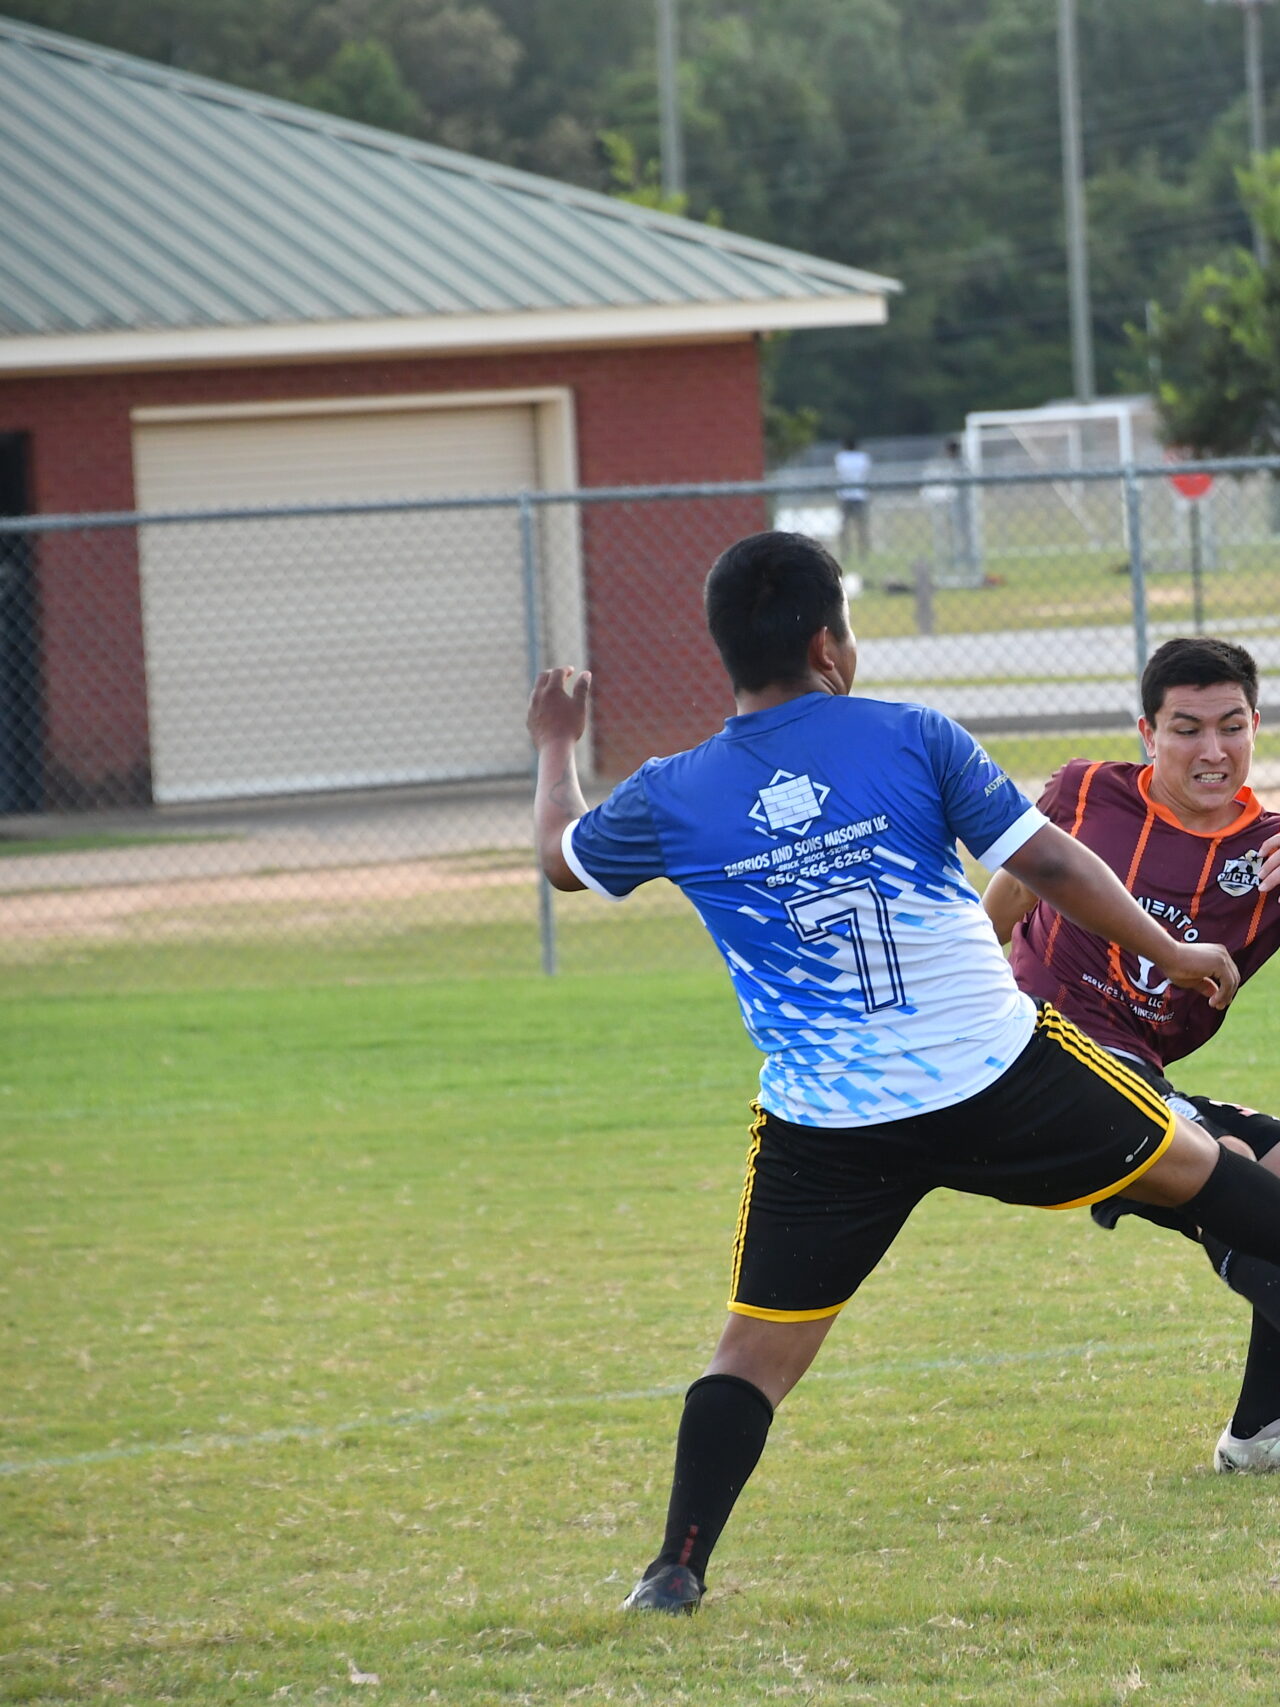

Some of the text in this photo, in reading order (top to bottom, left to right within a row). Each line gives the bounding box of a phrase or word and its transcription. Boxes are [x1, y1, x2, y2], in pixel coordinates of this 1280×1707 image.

[771, 845, 793, 865] AND
[794, 836, 823, 857] SONS
[824, 820, 873, 848] MASONRY
[873, 815, 889, 832] LLC
[784, 878, 906, 1014] 7
[1147, 997, 1164, 1008] LLC
